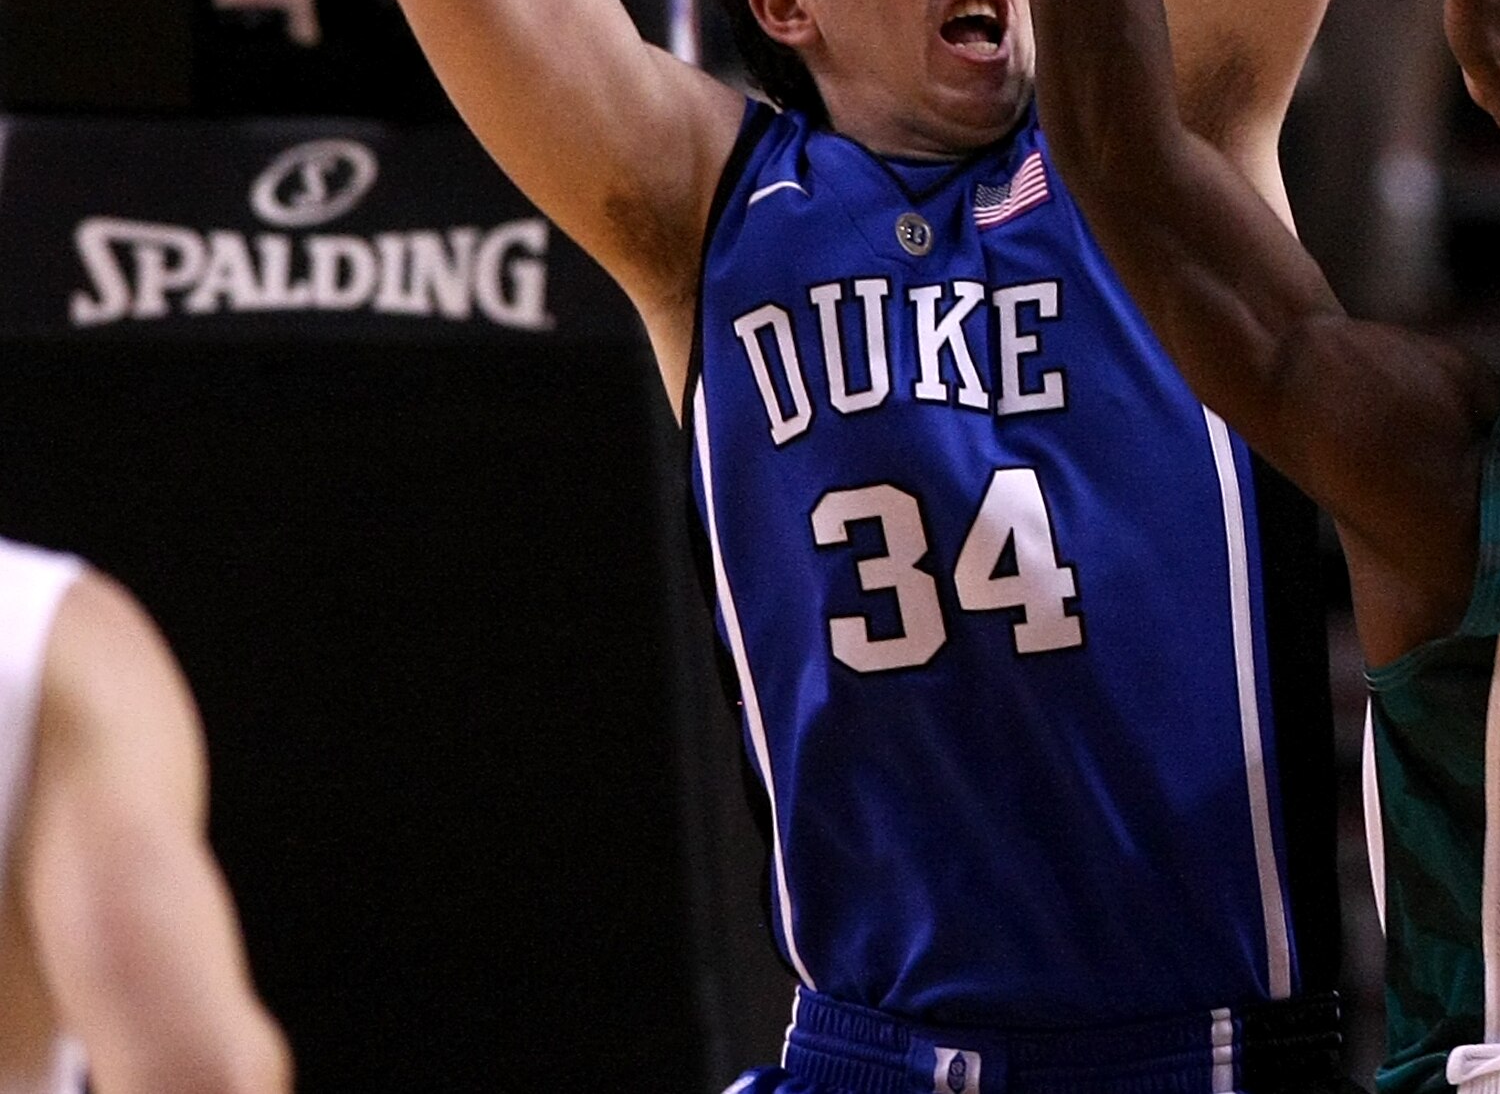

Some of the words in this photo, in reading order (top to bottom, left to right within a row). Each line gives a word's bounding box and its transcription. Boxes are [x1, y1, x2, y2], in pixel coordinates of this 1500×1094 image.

[70, 216, 555, 329] SPALDING
[733, 277, 1066, 446] DUKE
[809, 467, 1084, 674] 34
